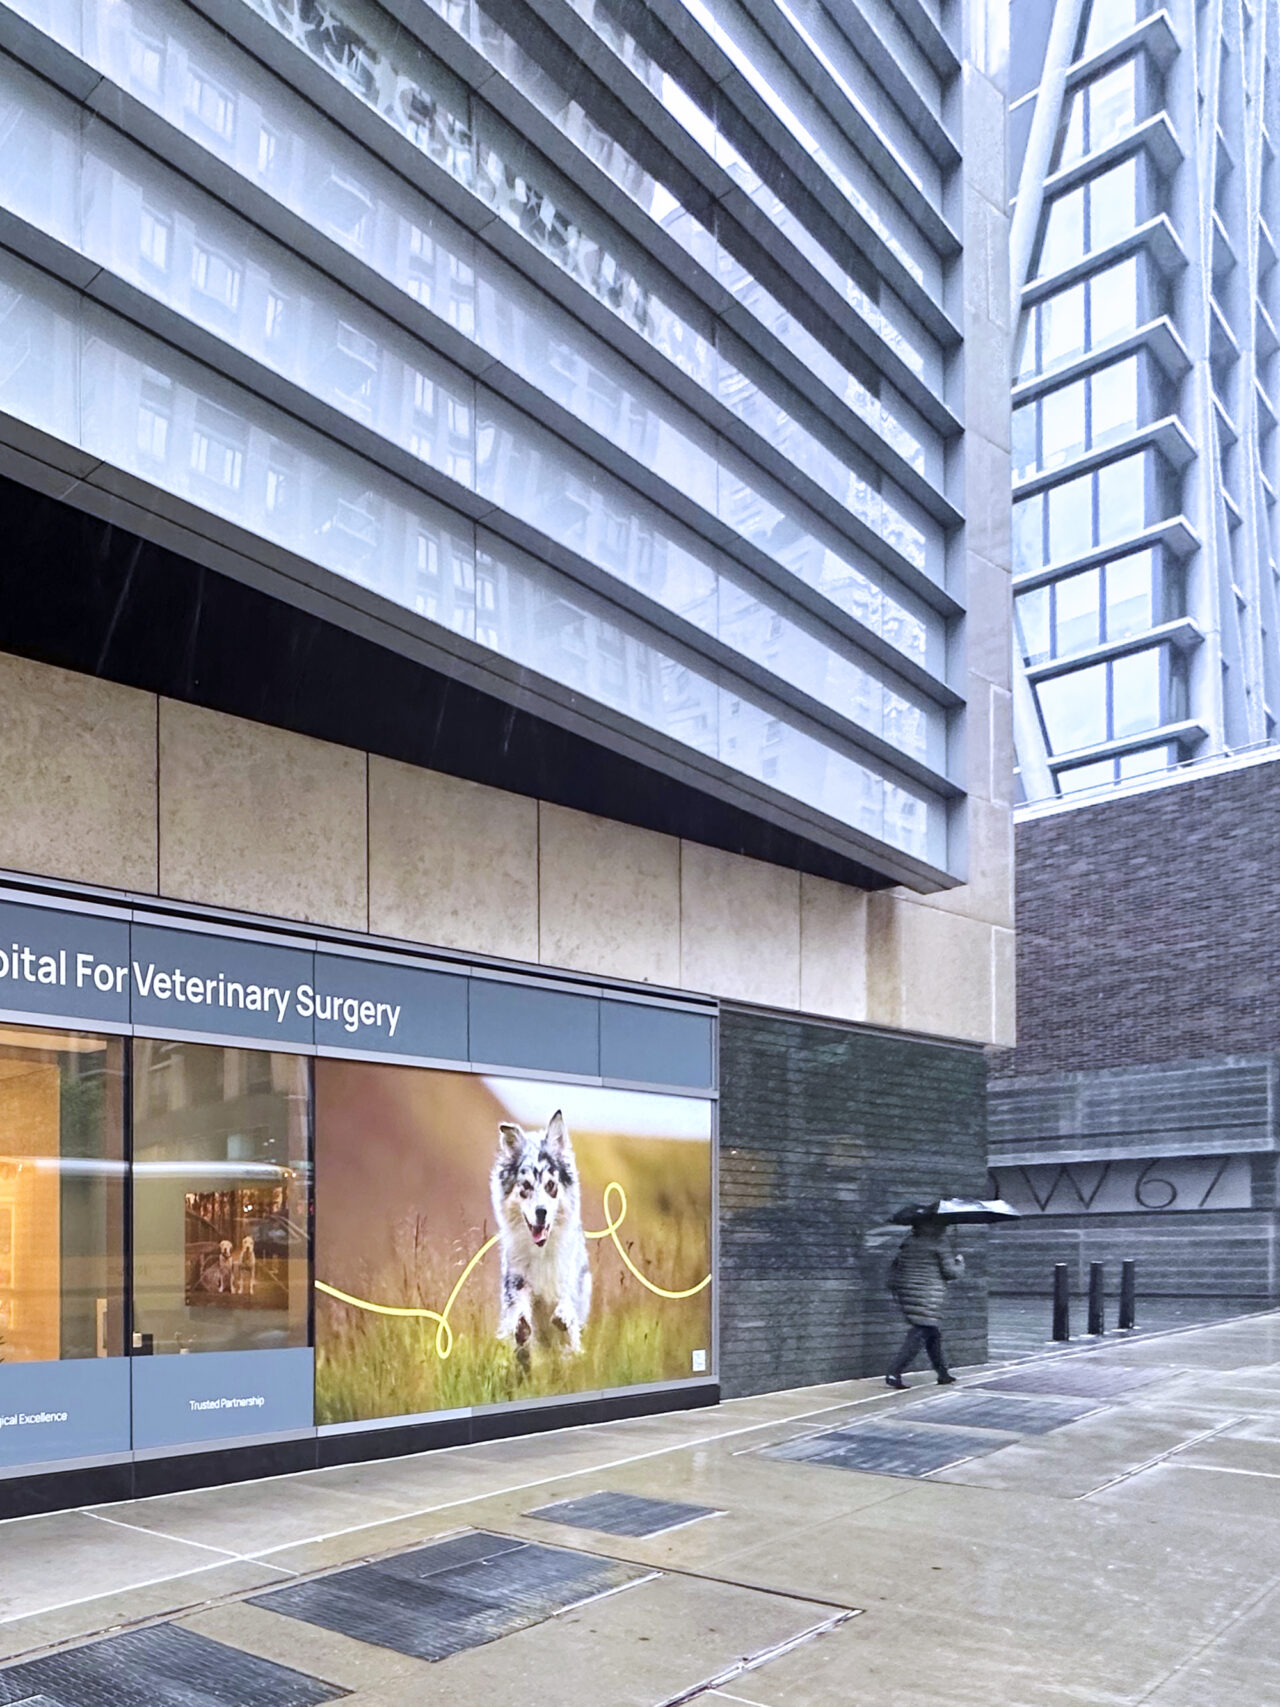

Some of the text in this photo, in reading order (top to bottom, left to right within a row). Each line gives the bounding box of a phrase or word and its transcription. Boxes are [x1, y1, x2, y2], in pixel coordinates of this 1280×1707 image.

[76, 953, 129, 993] For
[132, 961, 291, 1023] Veterinary
[295, 985, 401, 1037] Surgery
[1019, 1161, 1111, 1212] W
[1135, 1154, 1231, 1209] 67
[19, 1412, 68, 1425] Excellence
[189, 1395, 265, 1411] Trusted Partnership
